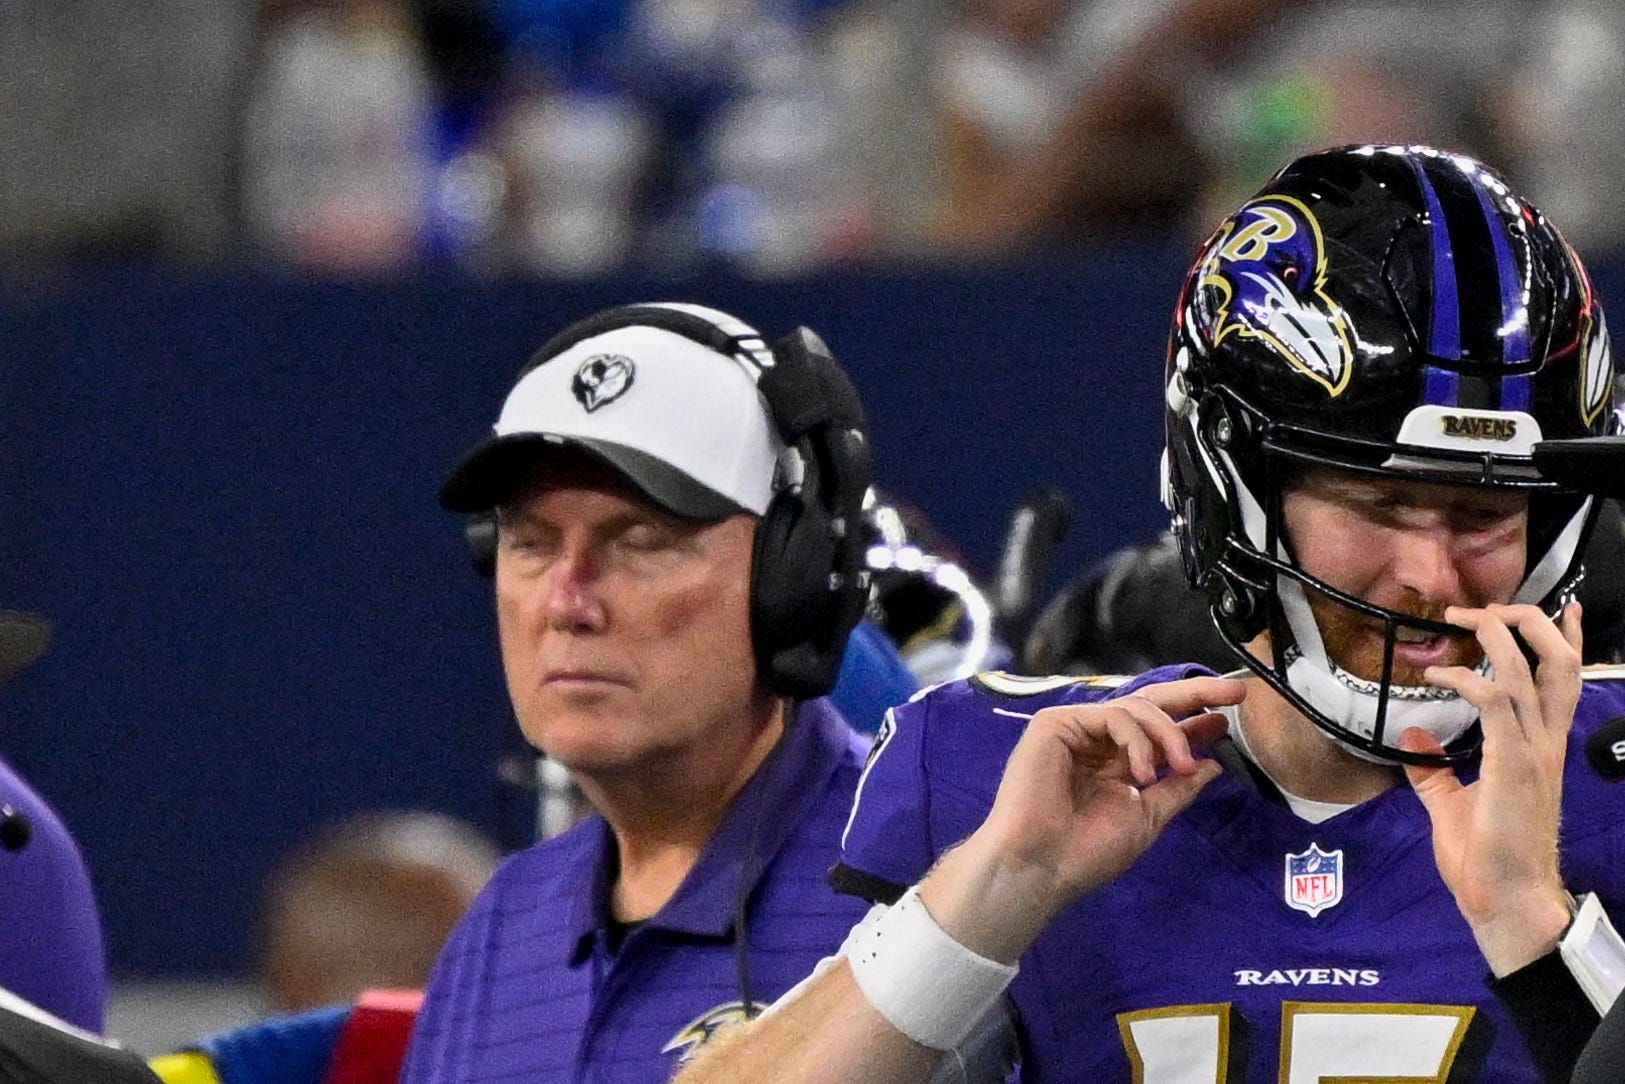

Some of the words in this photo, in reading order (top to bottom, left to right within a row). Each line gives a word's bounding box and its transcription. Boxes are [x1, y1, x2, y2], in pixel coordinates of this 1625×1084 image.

[1441, 414, 1517, 441] RAVENS
[1295, 875, 1333, 902] NFL
[1234, 968, 1380, 986] RAVENS
